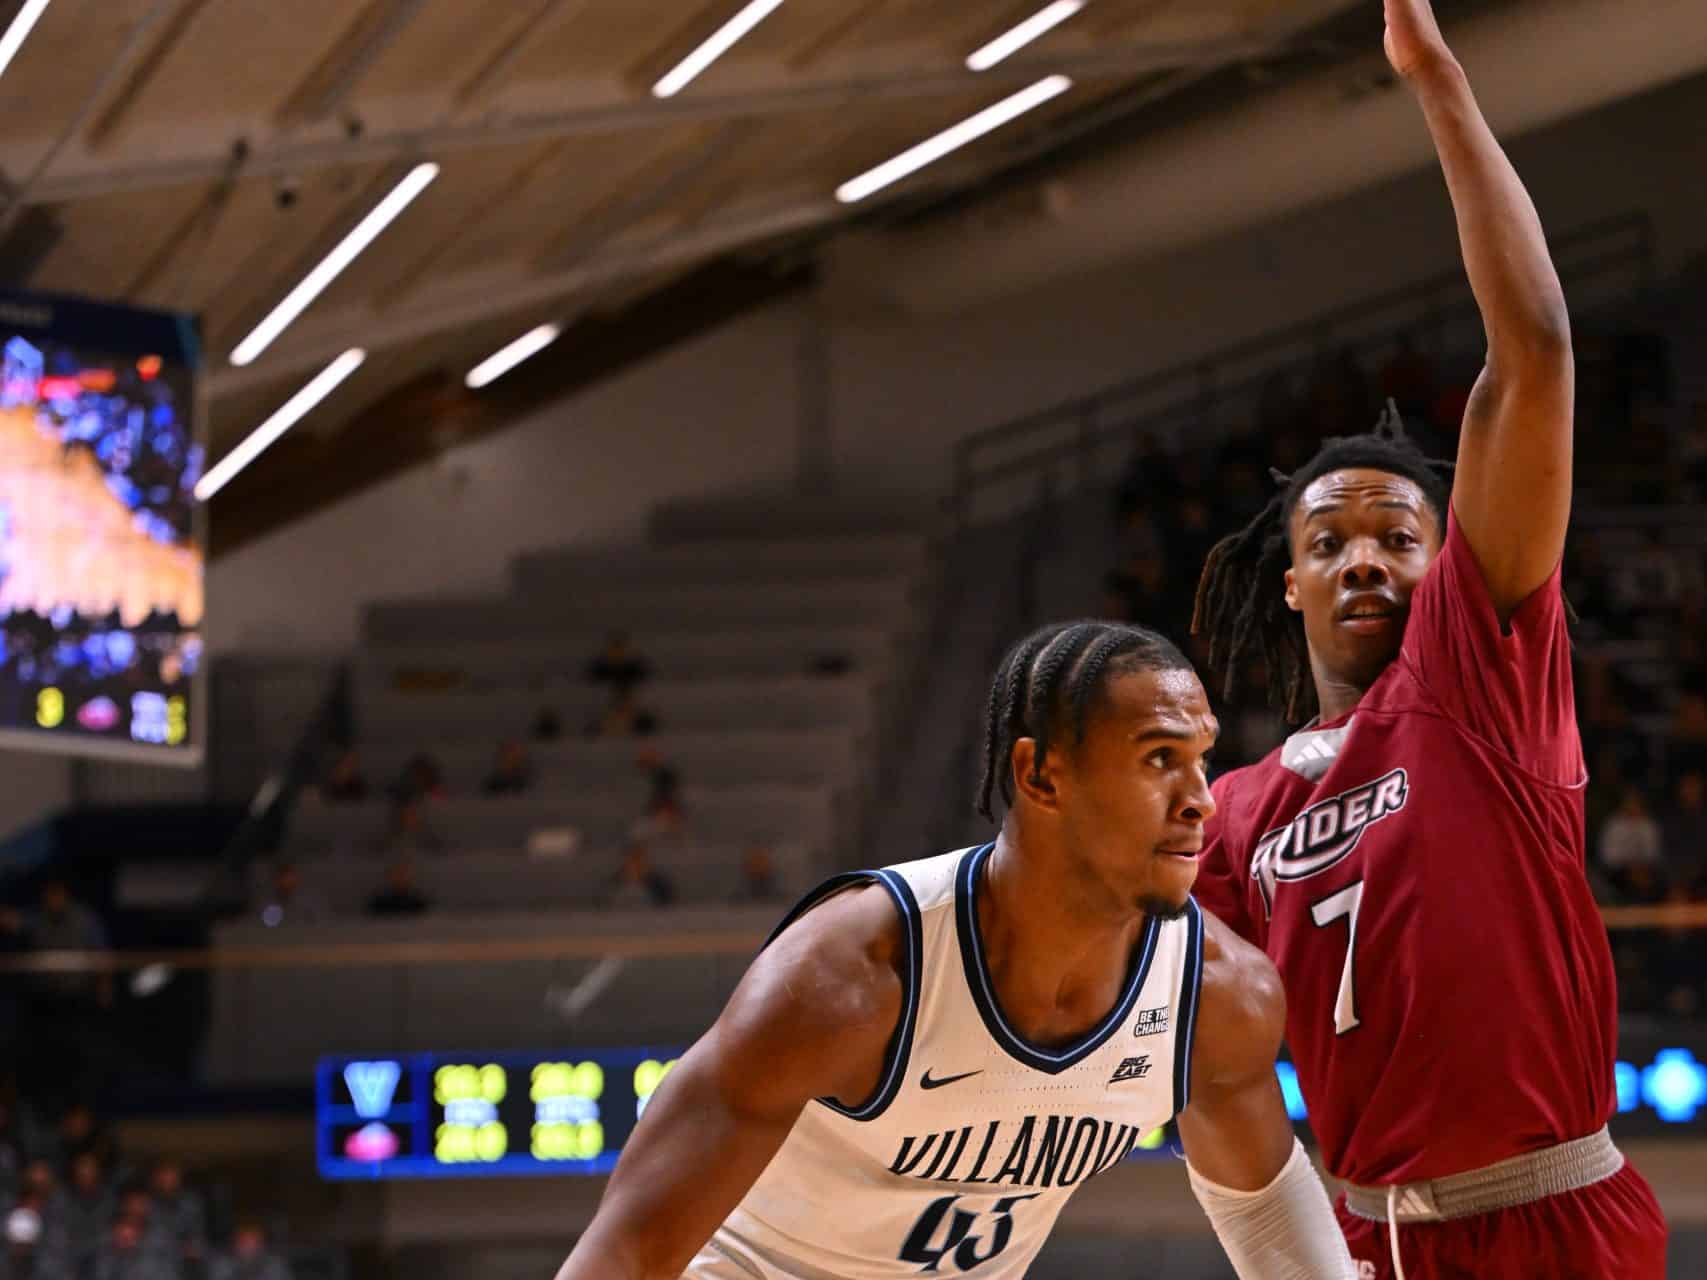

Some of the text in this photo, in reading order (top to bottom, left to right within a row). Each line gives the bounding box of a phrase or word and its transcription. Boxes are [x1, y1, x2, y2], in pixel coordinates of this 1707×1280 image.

[1311, 879, 1364, 1035] 7
[1140, 1007, 1168, 1023] BE TH
[1135, 1020, 1168, 1036] CHANG
[1112, 1064, 1152, 1078] EAST
